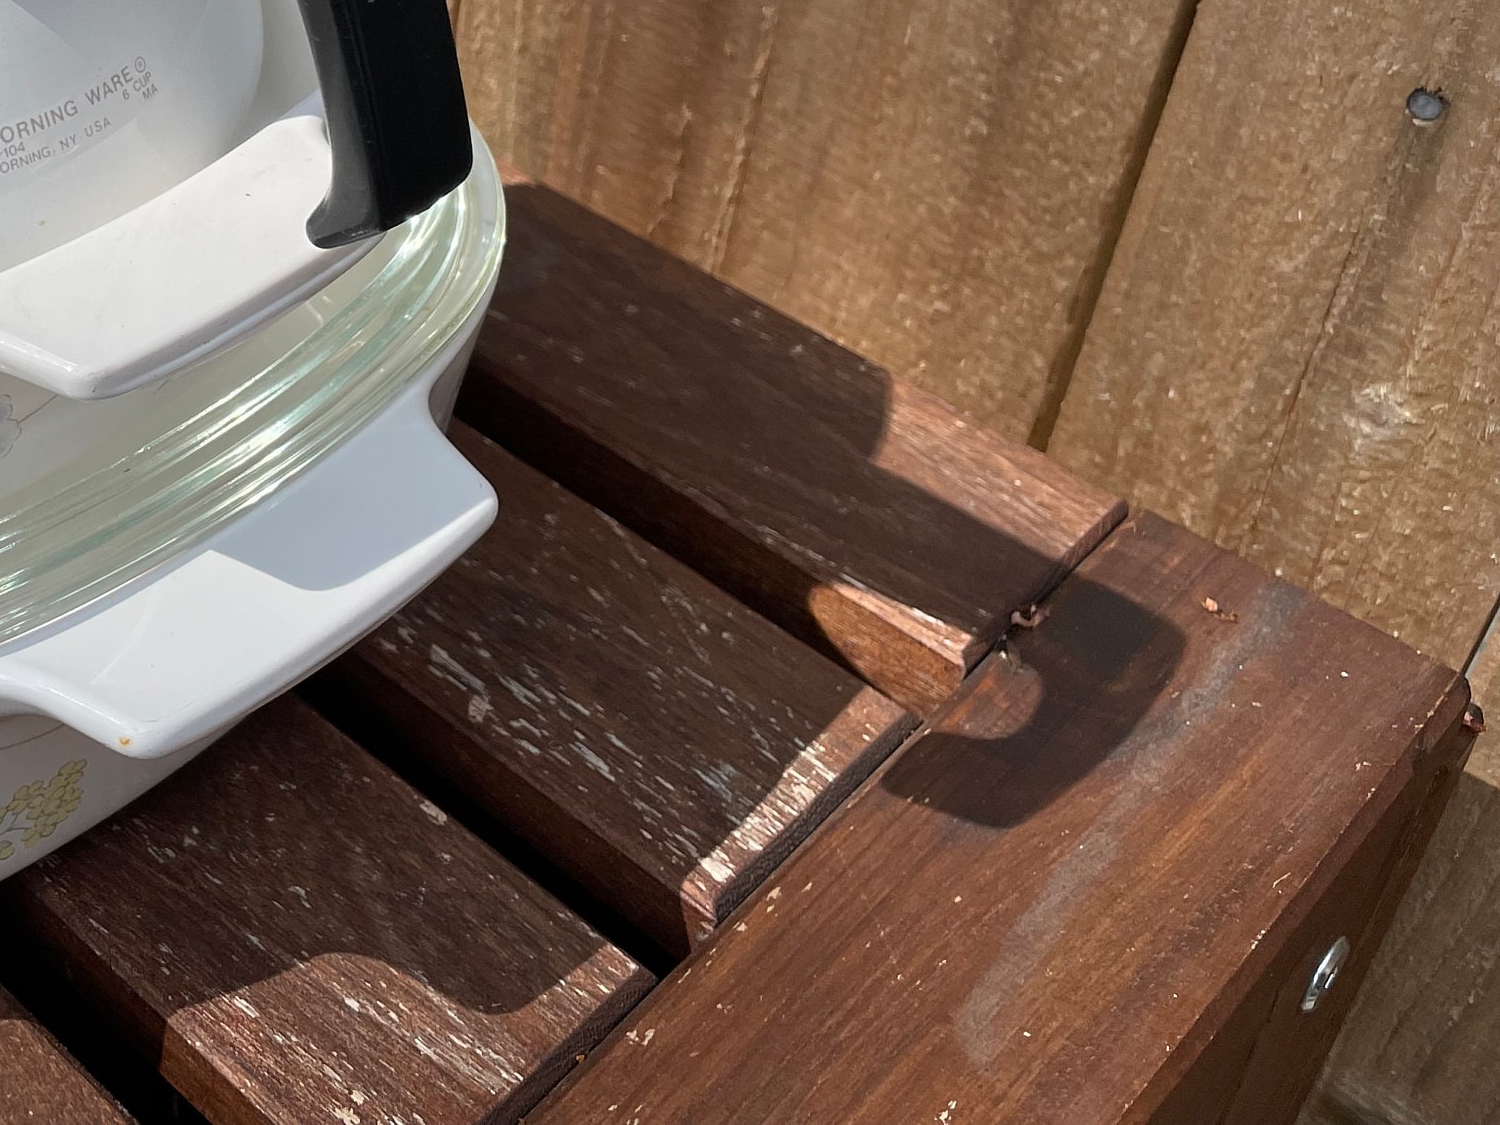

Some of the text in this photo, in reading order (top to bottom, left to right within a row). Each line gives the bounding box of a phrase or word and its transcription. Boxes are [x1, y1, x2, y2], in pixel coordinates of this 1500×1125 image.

[122, 89, 130, 101] 6
[133, 71, 152, 92] CUP
[84, 117, 111, 138] USA
